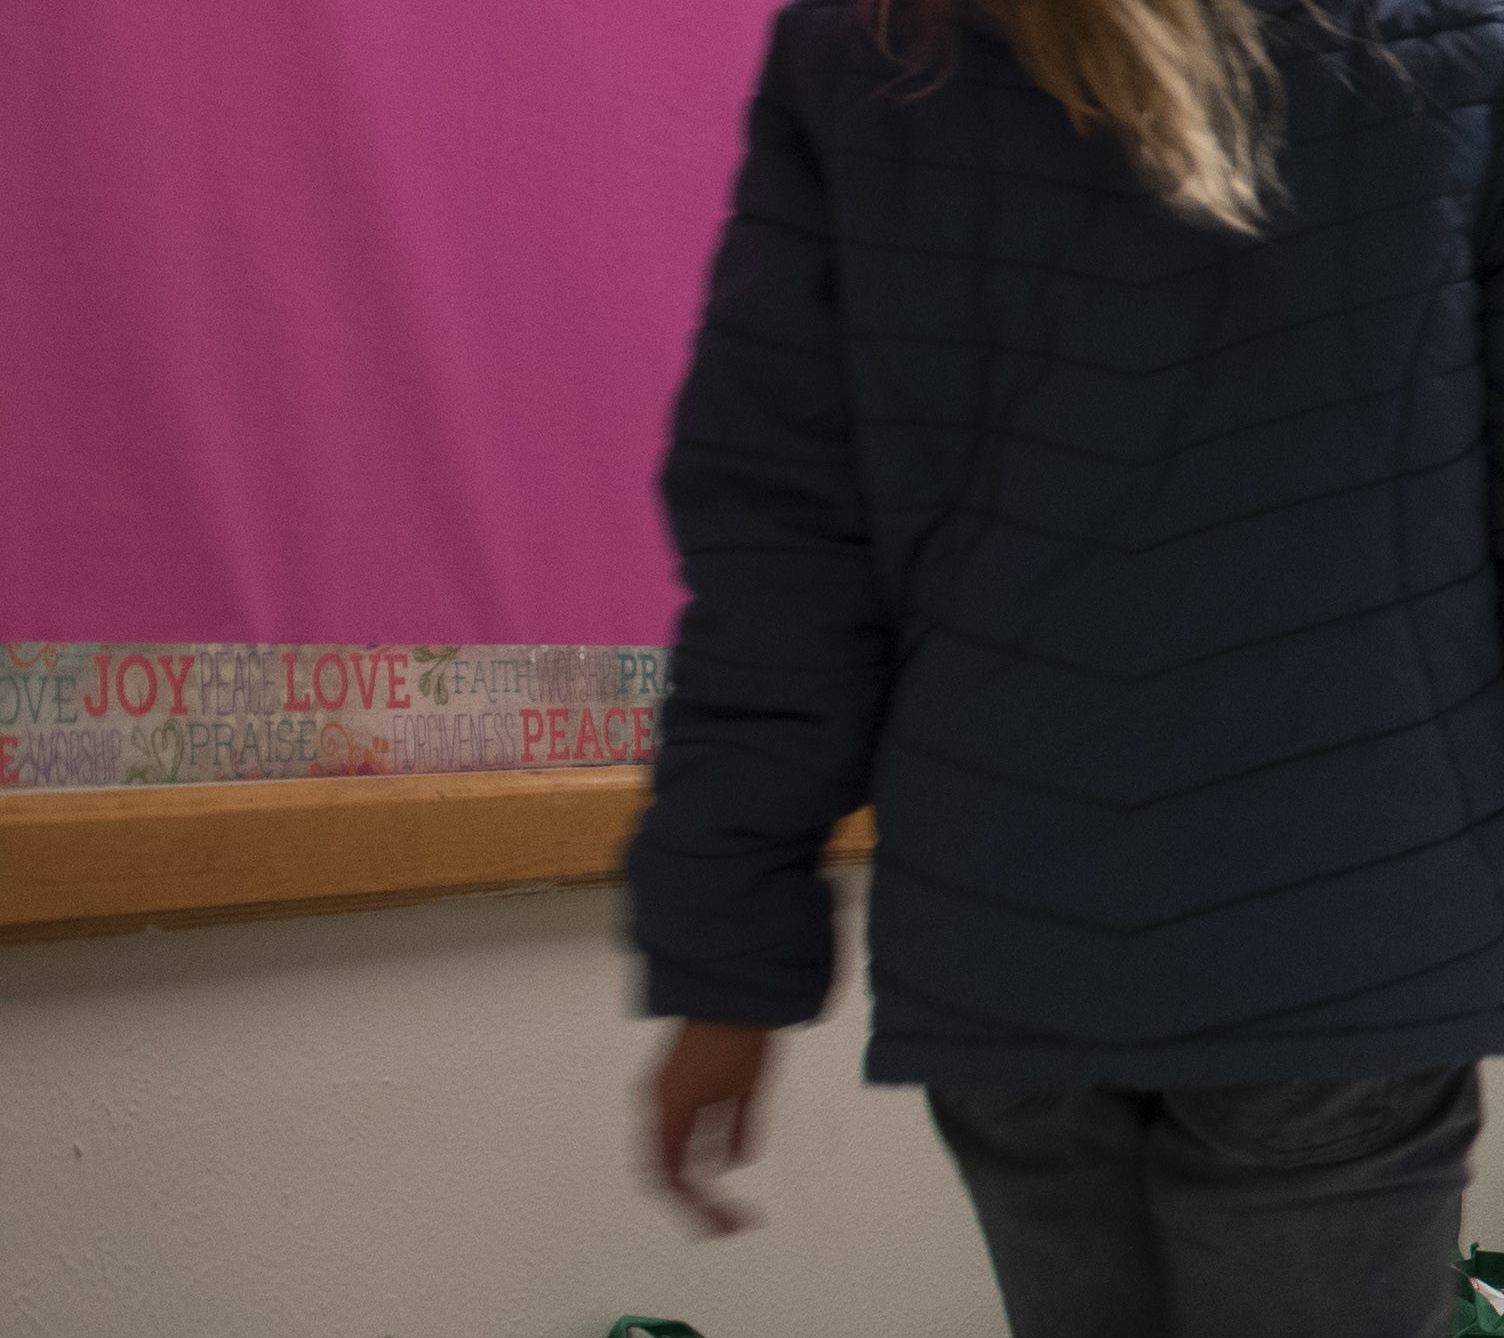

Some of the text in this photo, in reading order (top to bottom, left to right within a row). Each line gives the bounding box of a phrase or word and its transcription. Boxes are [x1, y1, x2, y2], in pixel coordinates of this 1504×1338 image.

[83, 649, 538, 719] JOY PEACE LOVE FAITH
[187, 719, 318, 767] PRAISE
[393, 712, 518, 770] FORGIVENESS
[519, 706, 656, 763] PEACE
